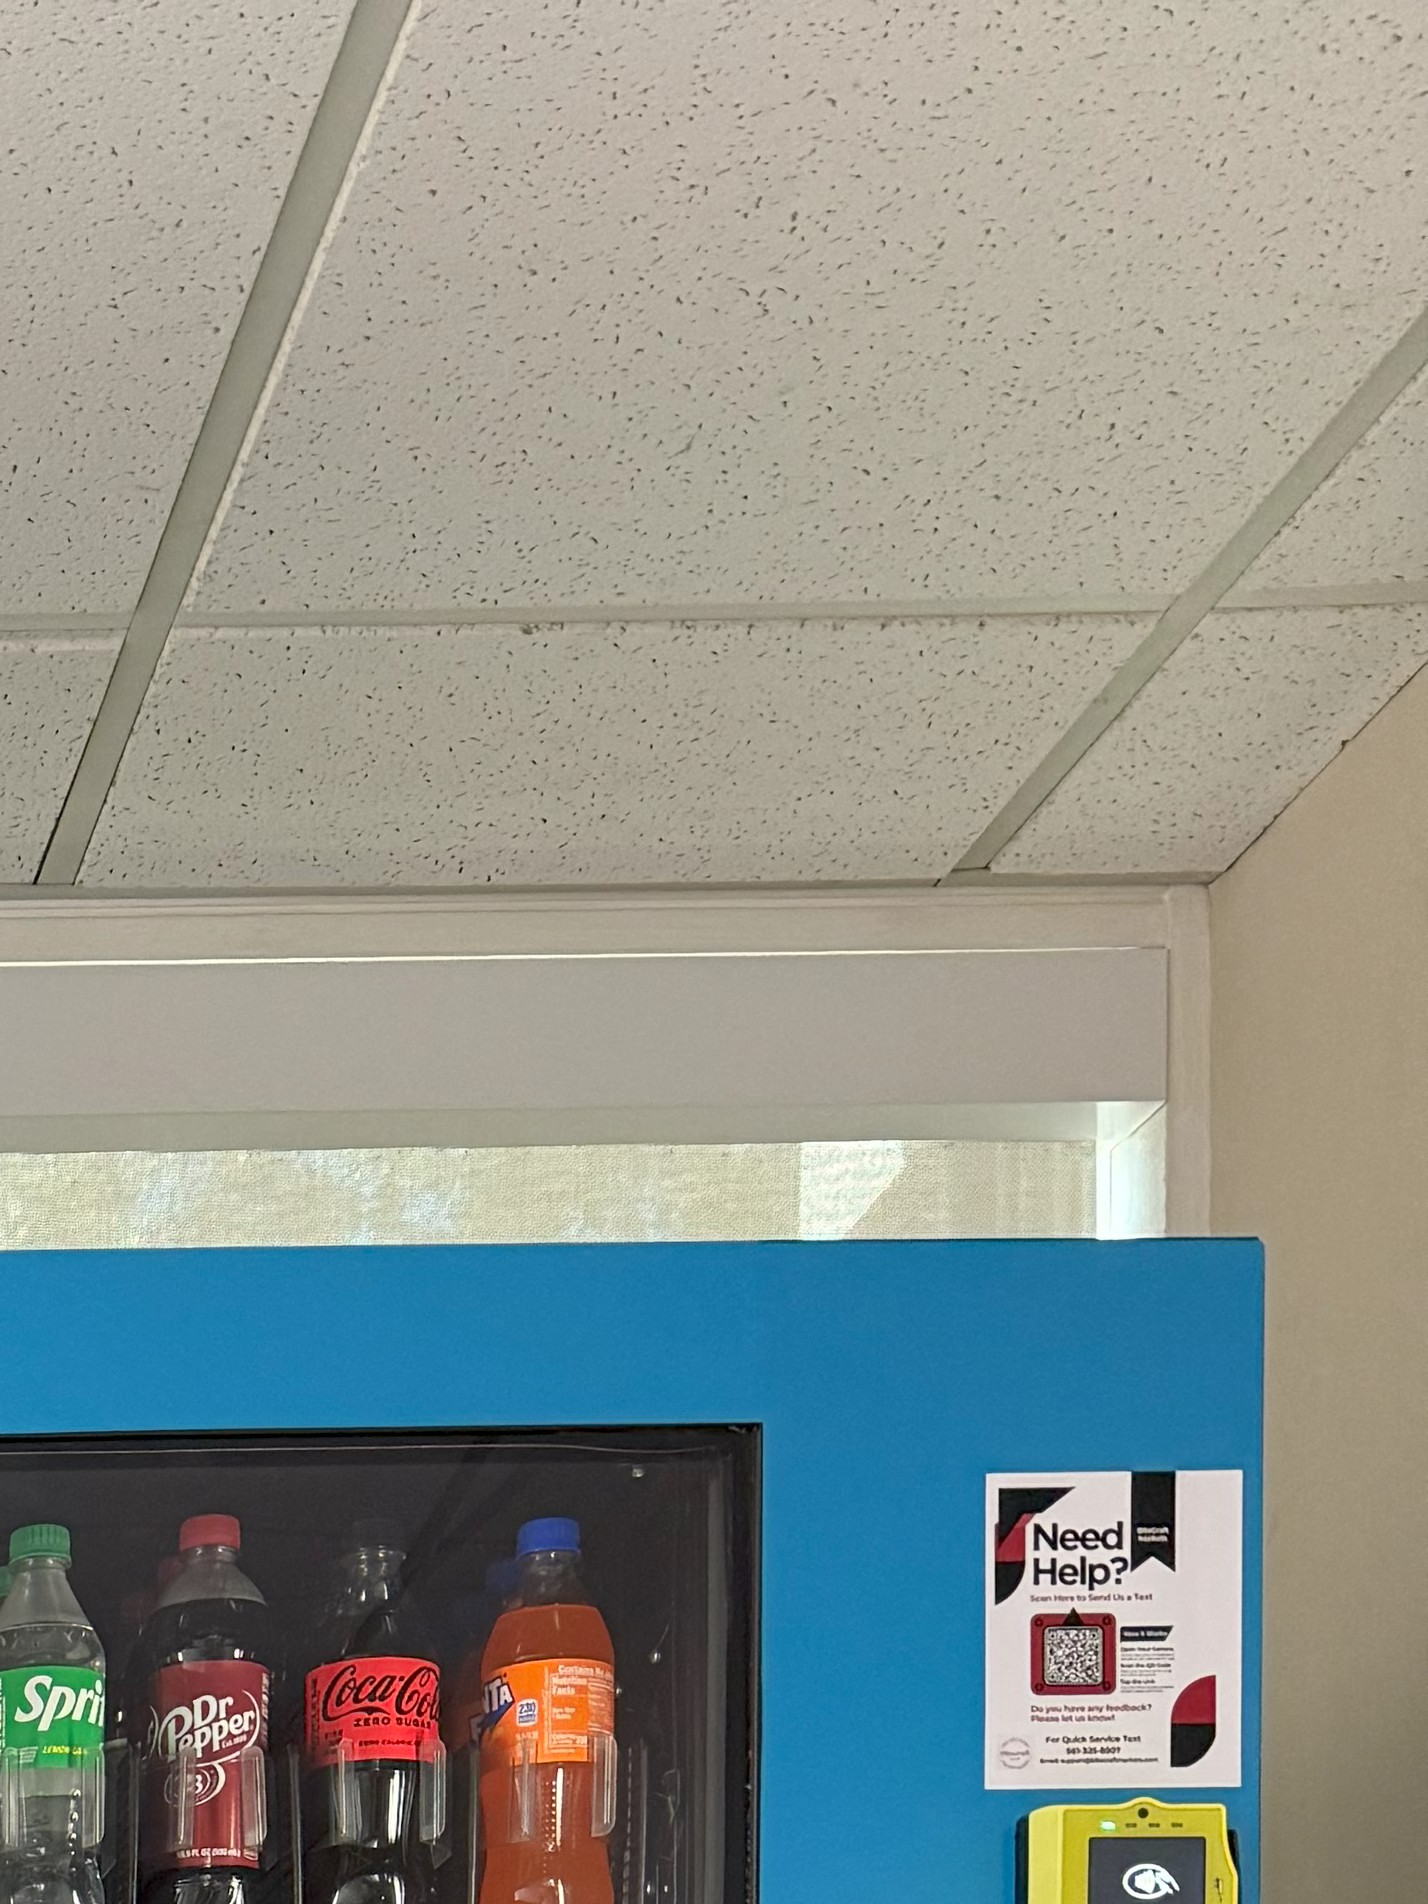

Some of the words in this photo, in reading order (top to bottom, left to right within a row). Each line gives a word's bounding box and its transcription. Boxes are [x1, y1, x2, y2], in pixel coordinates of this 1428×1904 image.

[1032, 1521, 1124, 1551] Need
[1032, 1556, 1129, 1591] Help?
[192, 1696, 232, 1727] Dr
[160, 1712, 256, 1762] Pepper
